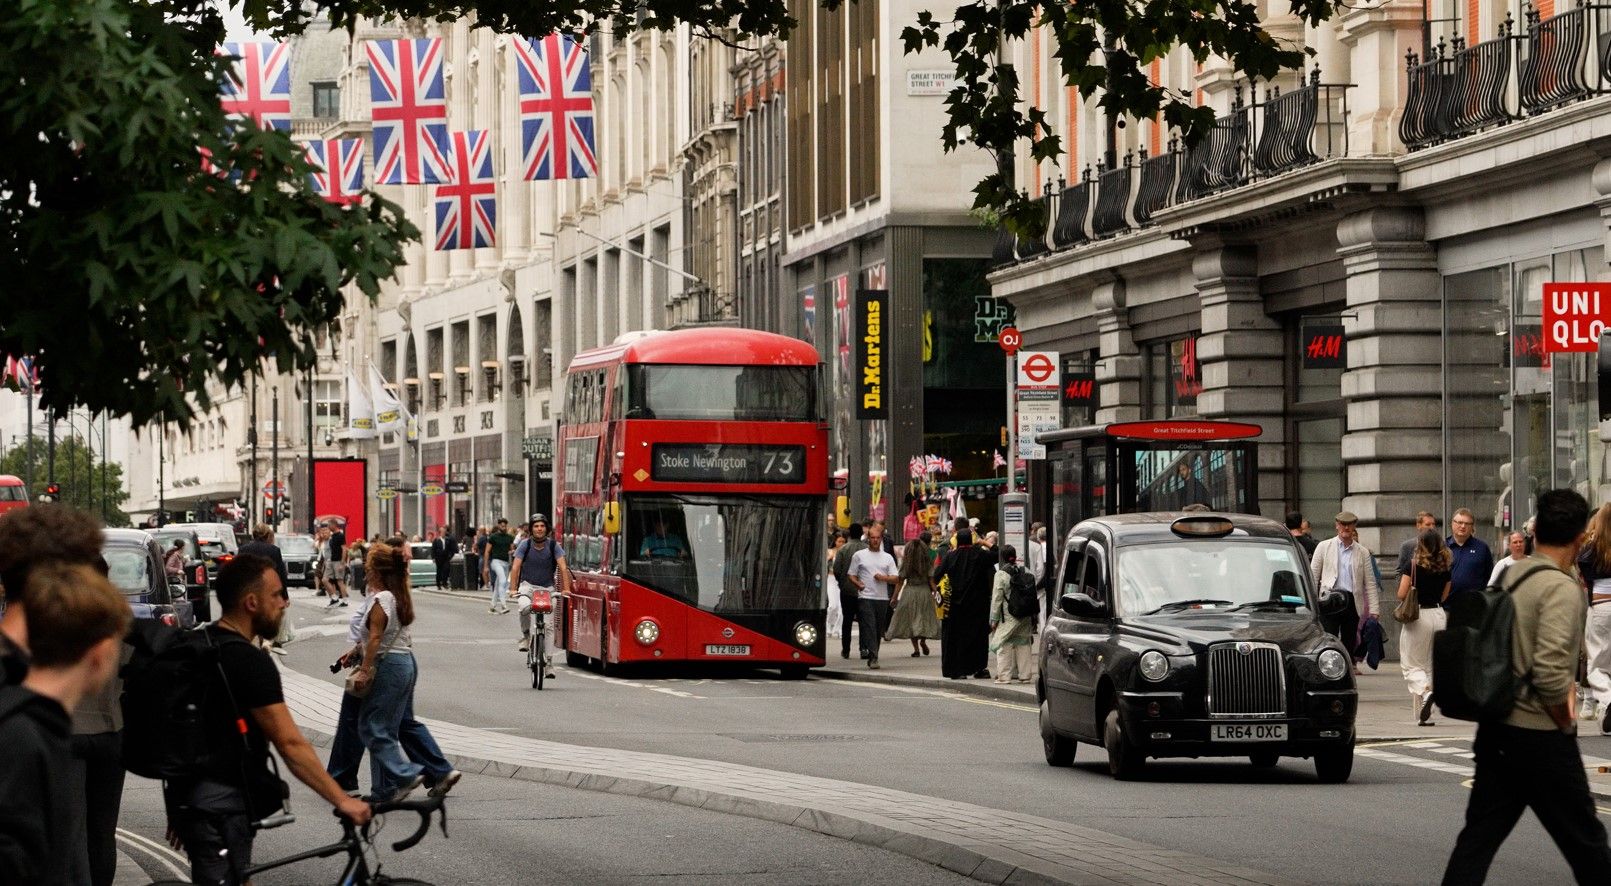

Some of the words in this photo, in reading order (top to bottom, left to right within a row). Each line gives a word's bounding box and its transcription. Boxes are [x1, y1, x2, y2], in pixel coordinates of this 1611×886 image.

[1552, 291, 1600, 315] UNI
[864, 300, 881, 385] Martens
[1003, 335, 1019, 346] OJ
[1307, 335, 1341, 359] H&M
[1066, 380, 1093, 399] H&M
[661, 453, 690, 468] Stoke
[693, 454, 747, 472] Newington
[763, 452, 793, 475] 73
[1217, 726, 1252, 738] LR64
[1256, 726, 1282, 738] OXC
